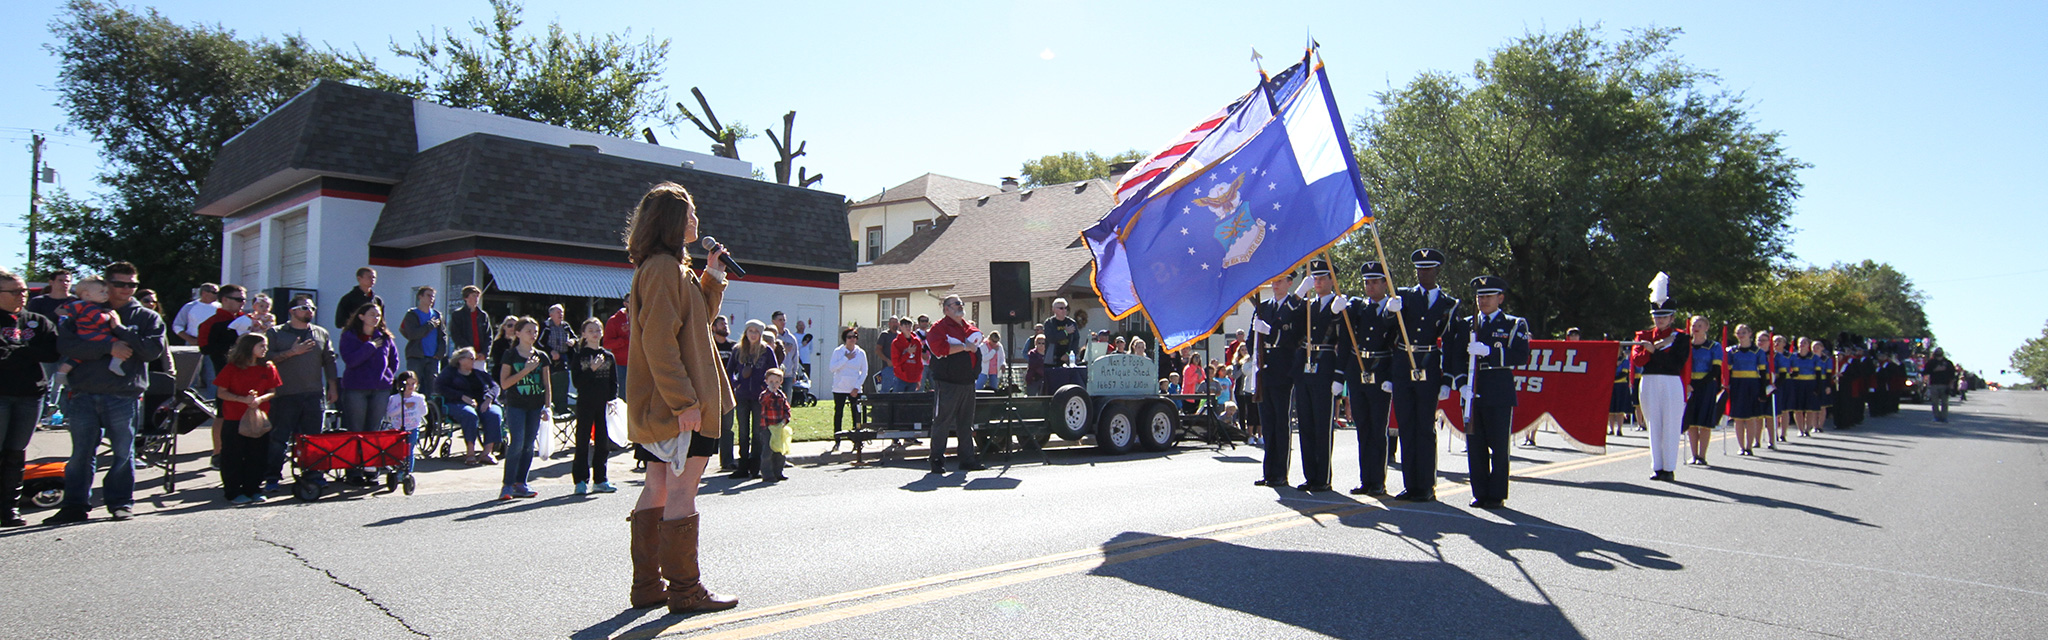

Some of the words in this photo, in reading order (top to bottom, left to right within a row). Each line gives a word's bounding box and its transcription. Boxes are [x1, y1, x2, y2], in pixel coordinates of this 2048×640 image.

[1510, 349, 1588, 374] ILL
[1101, 365, 1131, 379] Antique
[1133, 366, 1150, 377] Shed
[1120, 380, 1130, 389] SW
